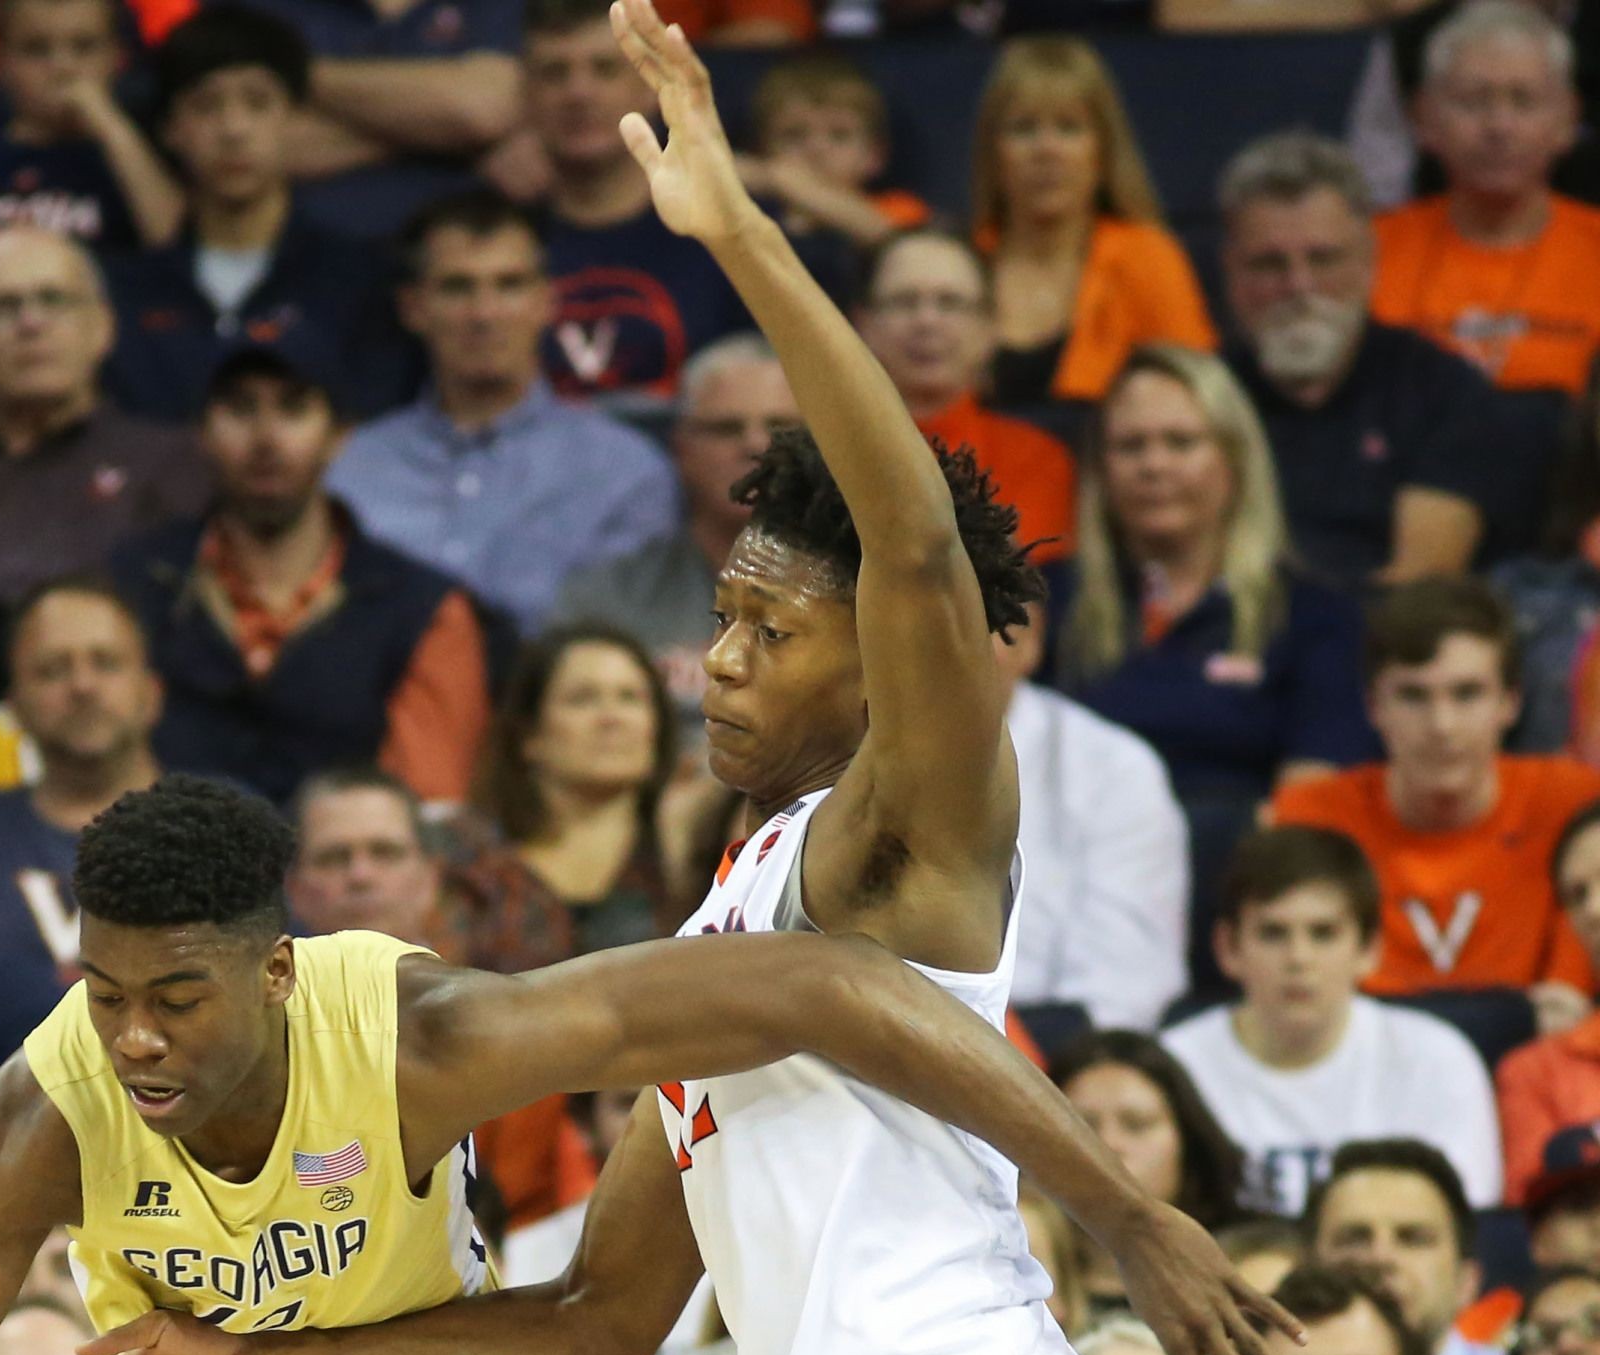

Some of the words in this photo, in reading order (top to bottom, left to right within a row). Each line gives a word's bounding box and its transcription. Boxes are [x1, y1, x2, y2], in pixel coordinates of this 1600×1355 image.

[1400, 891, 1483, 972] V
[123, 1208, 182, 1217] RUSSELL
[122, 1217, 368, 1307] GEORGIA
